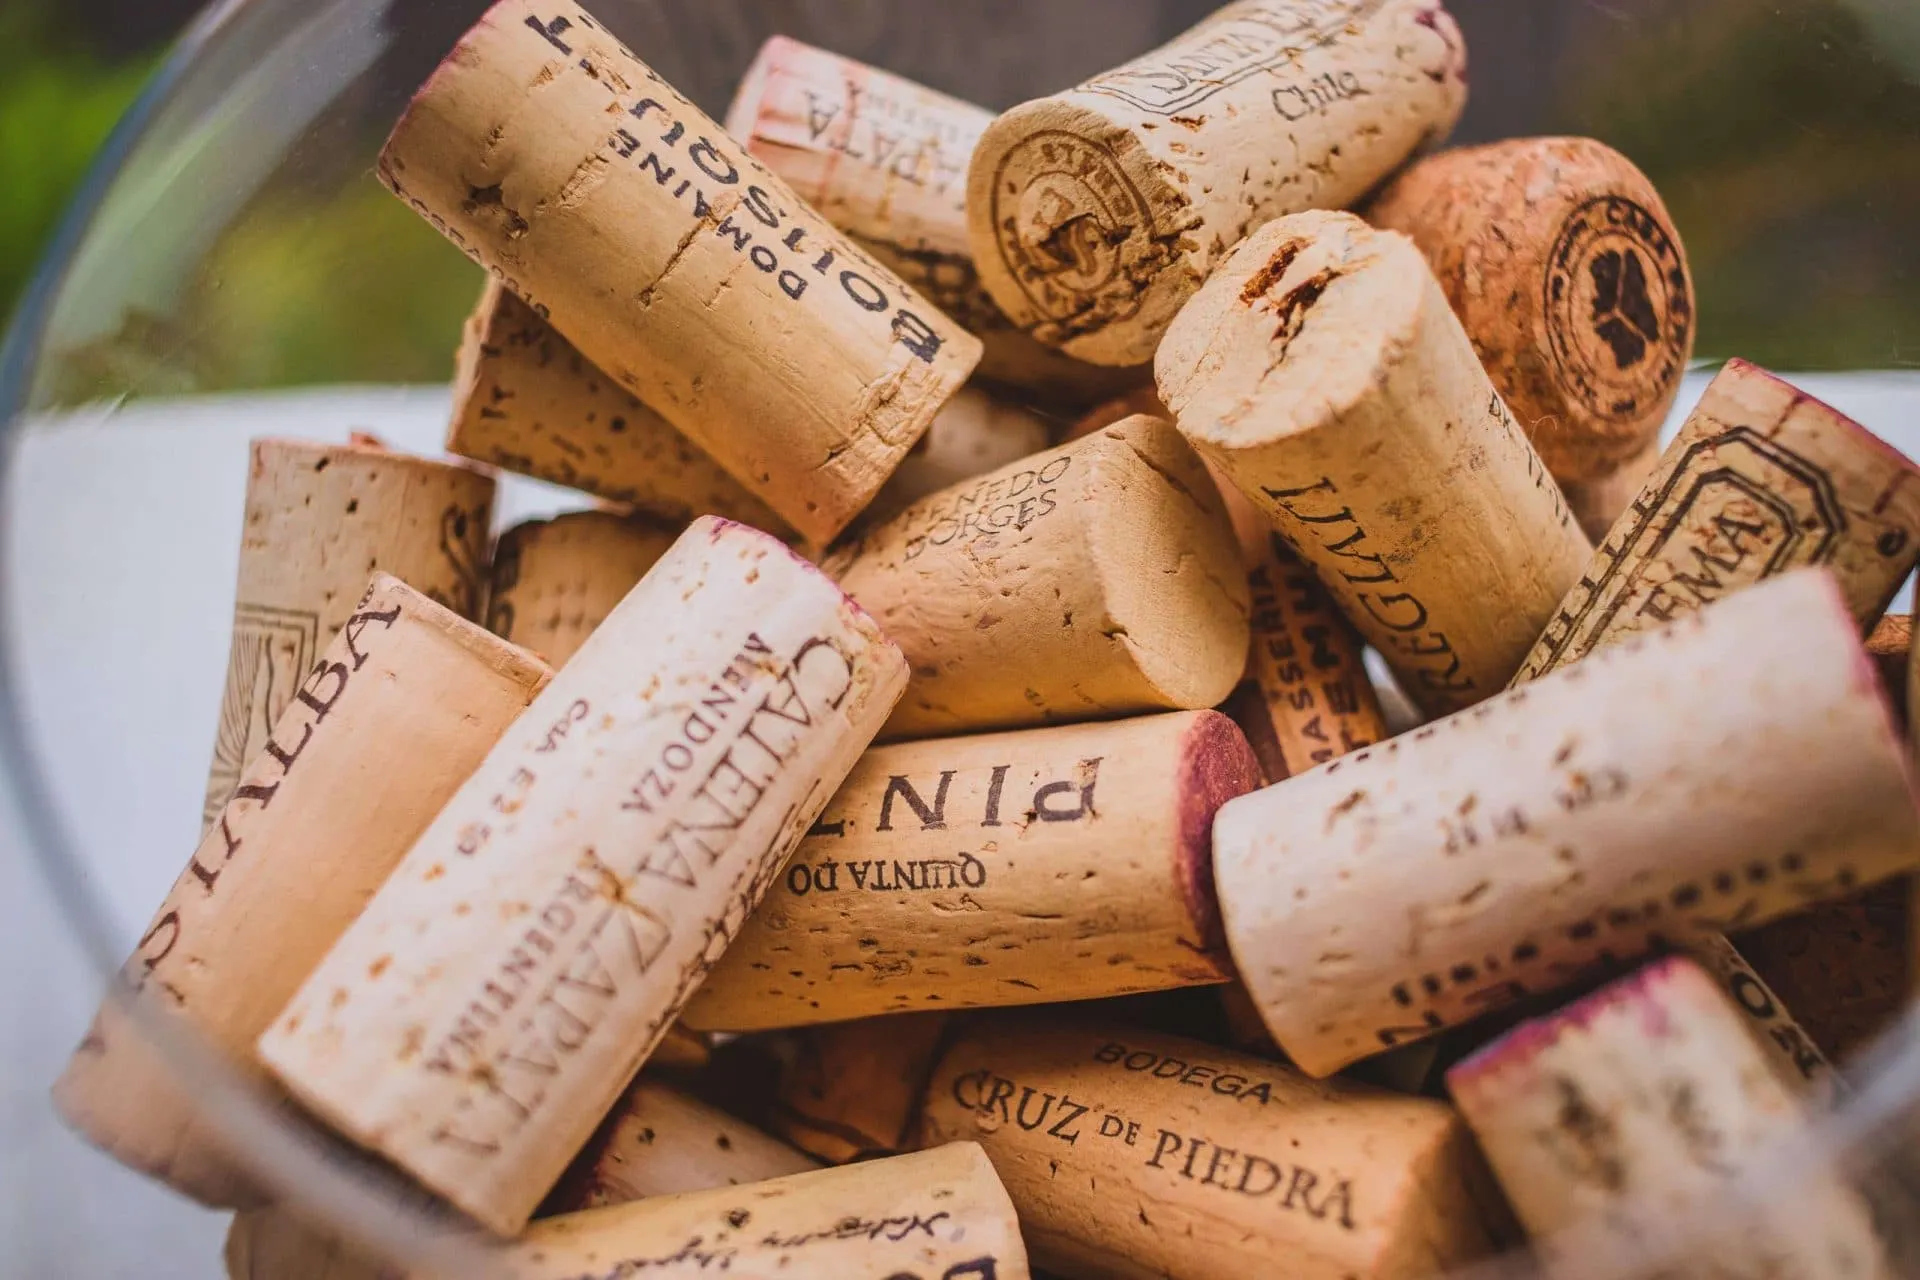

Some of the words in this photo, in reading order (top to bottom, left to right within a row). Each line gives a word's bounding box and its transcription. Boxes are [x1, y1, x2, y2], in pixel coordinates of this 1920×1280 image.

[1271, 71, 1361, 121] Chile
[804, 88, 965, 208] APATA
[608, 127, 809, 301] DOMAINE
[903, 487, 1057, 562] BORGES
[621, 631, 777, 813] MENDOZA
[637, 635, 857, 890] CATENA
[786, 856, 839, 897] DO
[848, 850, 988, 891] QUINTA
[1092, 1041, 1275, 1106] BODEGA
[951, 1068, 1091, 1147] CRUZ
[1099, 1111, 1143, 1147] DE
[1145, 1127, 1357, 1230] PIEDRA
